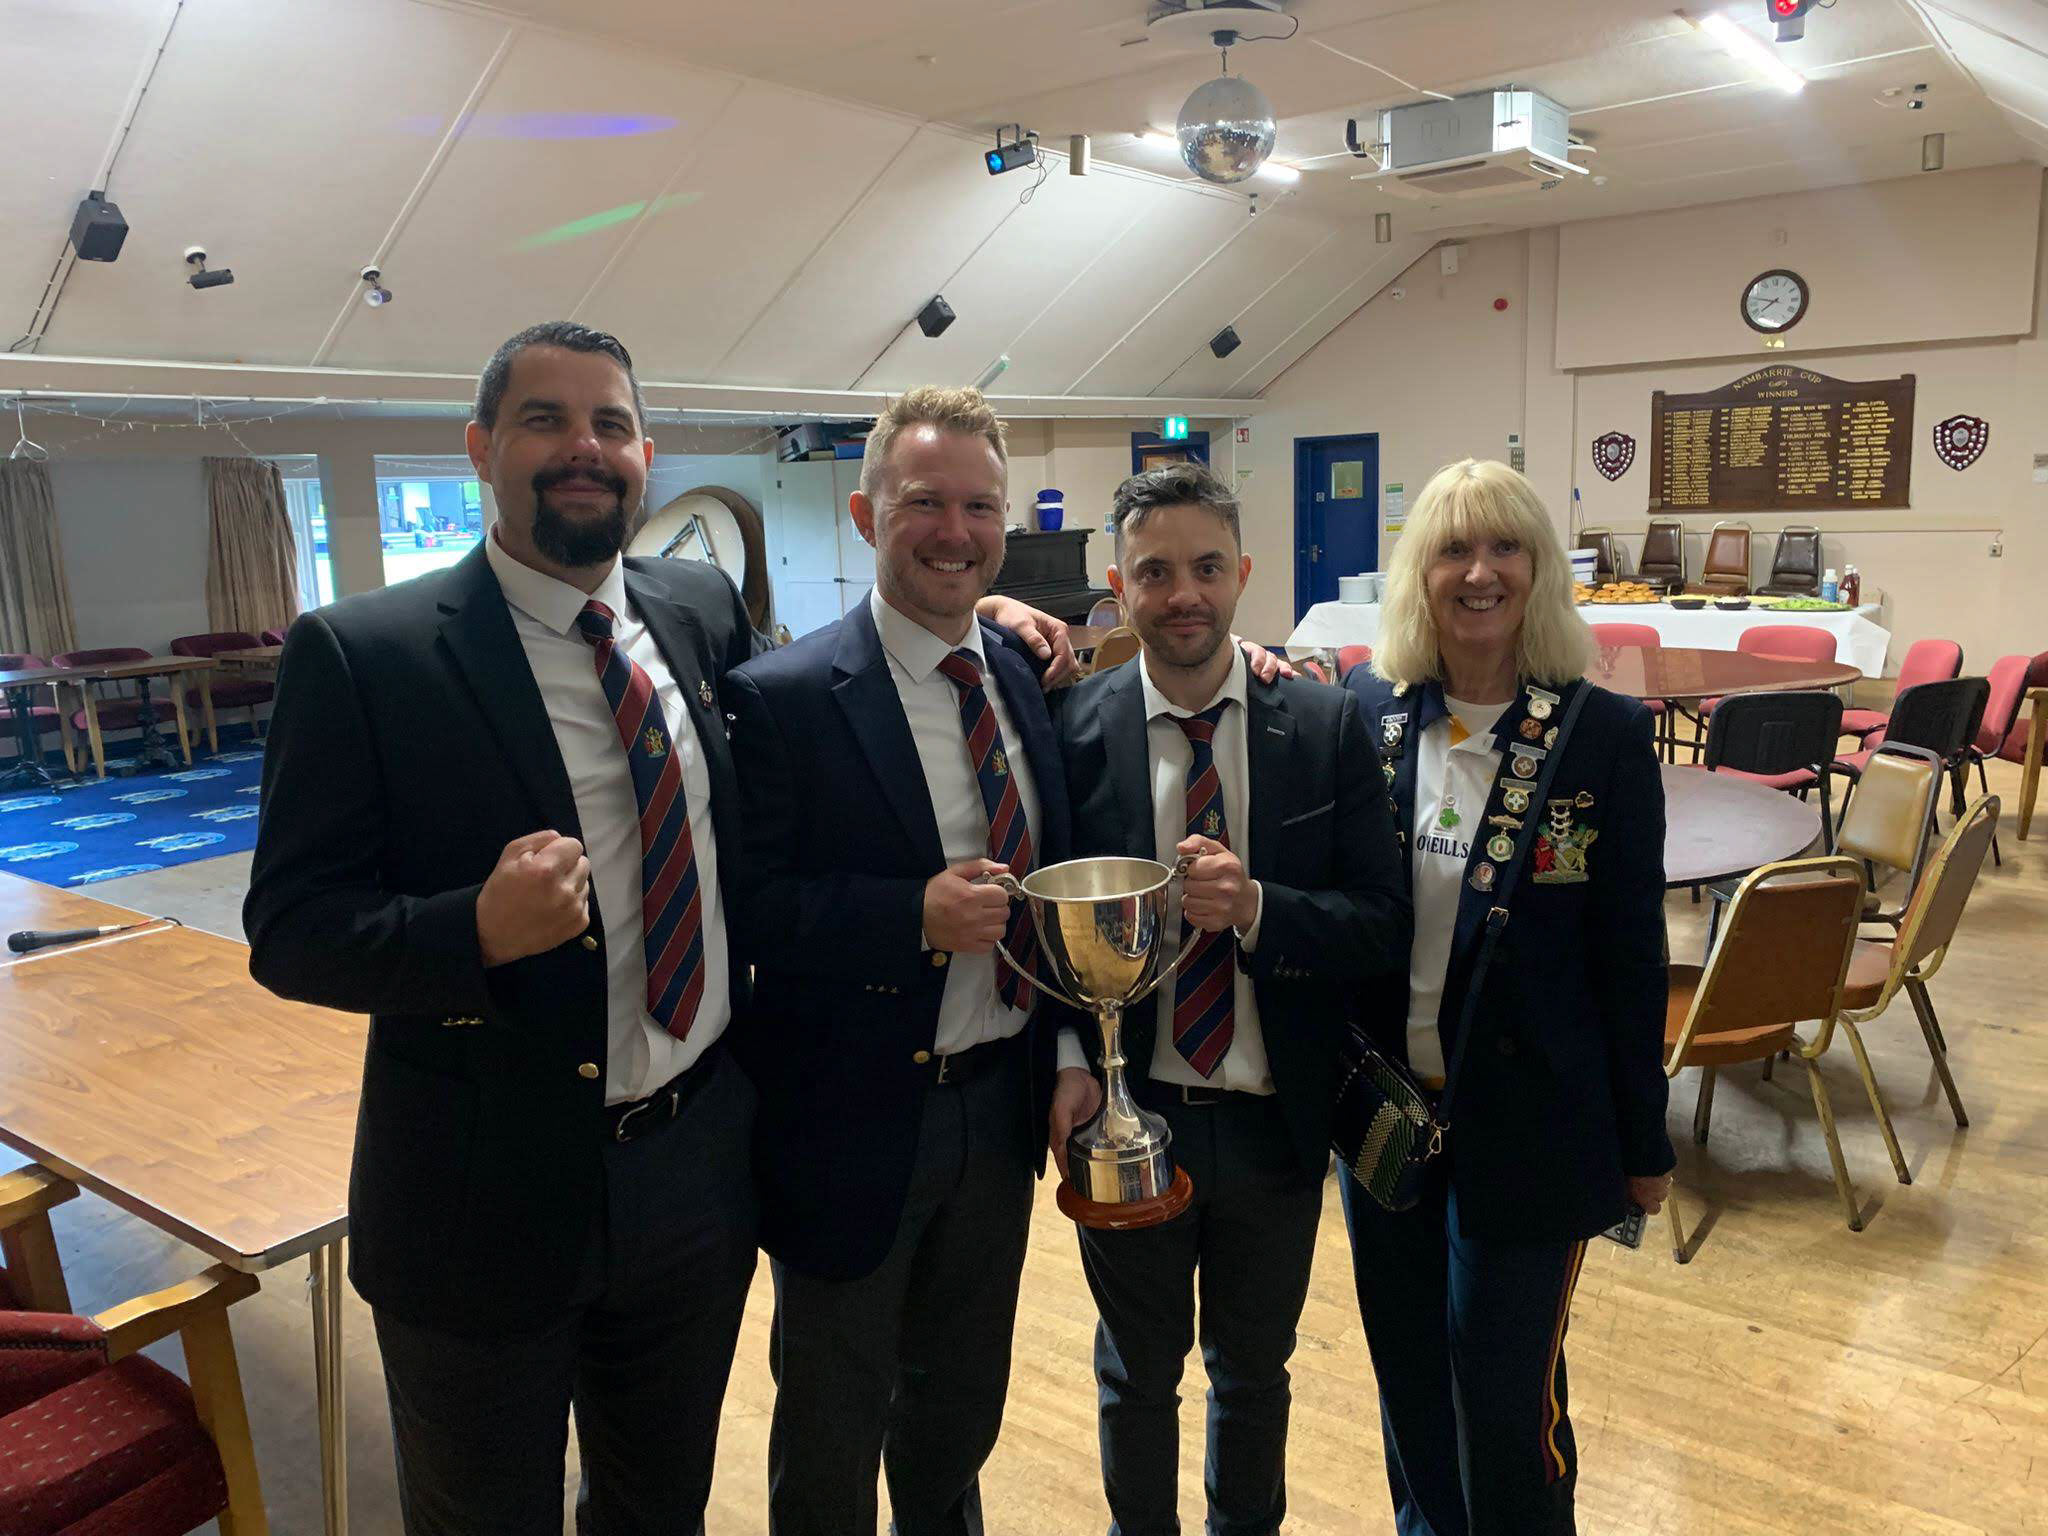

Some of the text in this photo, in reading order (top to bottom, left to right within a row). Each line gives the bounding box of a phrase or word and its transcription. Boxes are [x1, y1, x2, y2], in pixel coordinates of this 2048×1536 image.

[1733, 368, 1792, 391] NAMBARRIE
[1800, 371, 1822, 384] CUP
[1758, 389, 1799, 399] WINNERS
[1416, 834, 1469, 859] OEILLS
